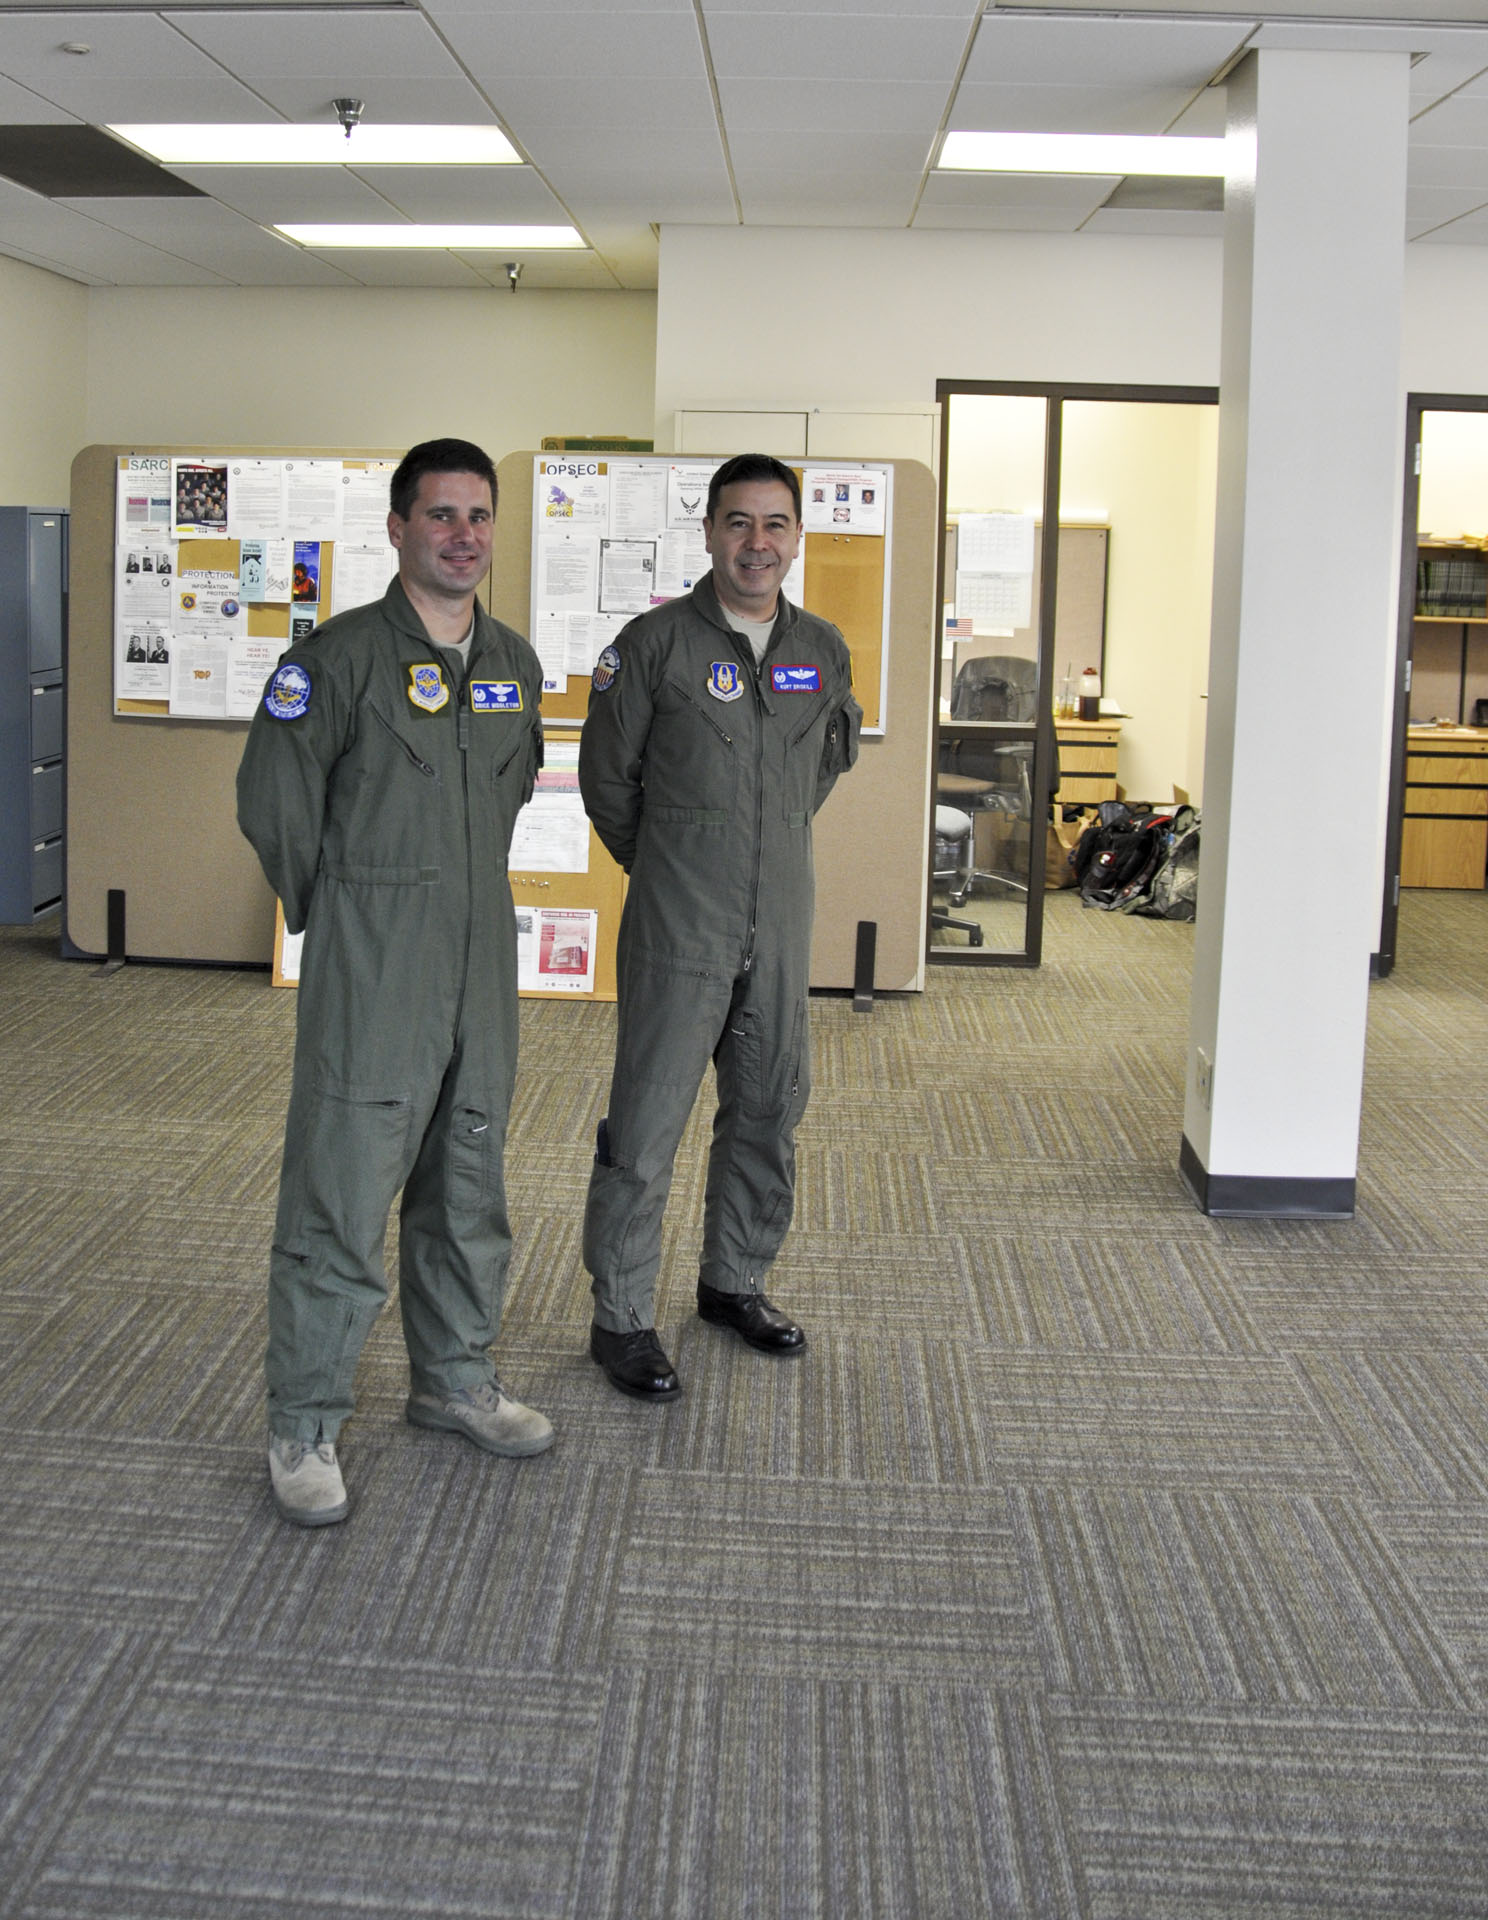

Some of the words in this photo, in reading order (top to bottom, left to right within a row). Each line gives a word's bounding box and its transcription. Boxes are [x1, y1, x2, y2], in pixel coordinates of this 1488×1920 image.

[130, 459, 169, 471] SARC
[547, 464, 597, 475] OPSEC
[183, 570, 235, 579] PROTECTION
